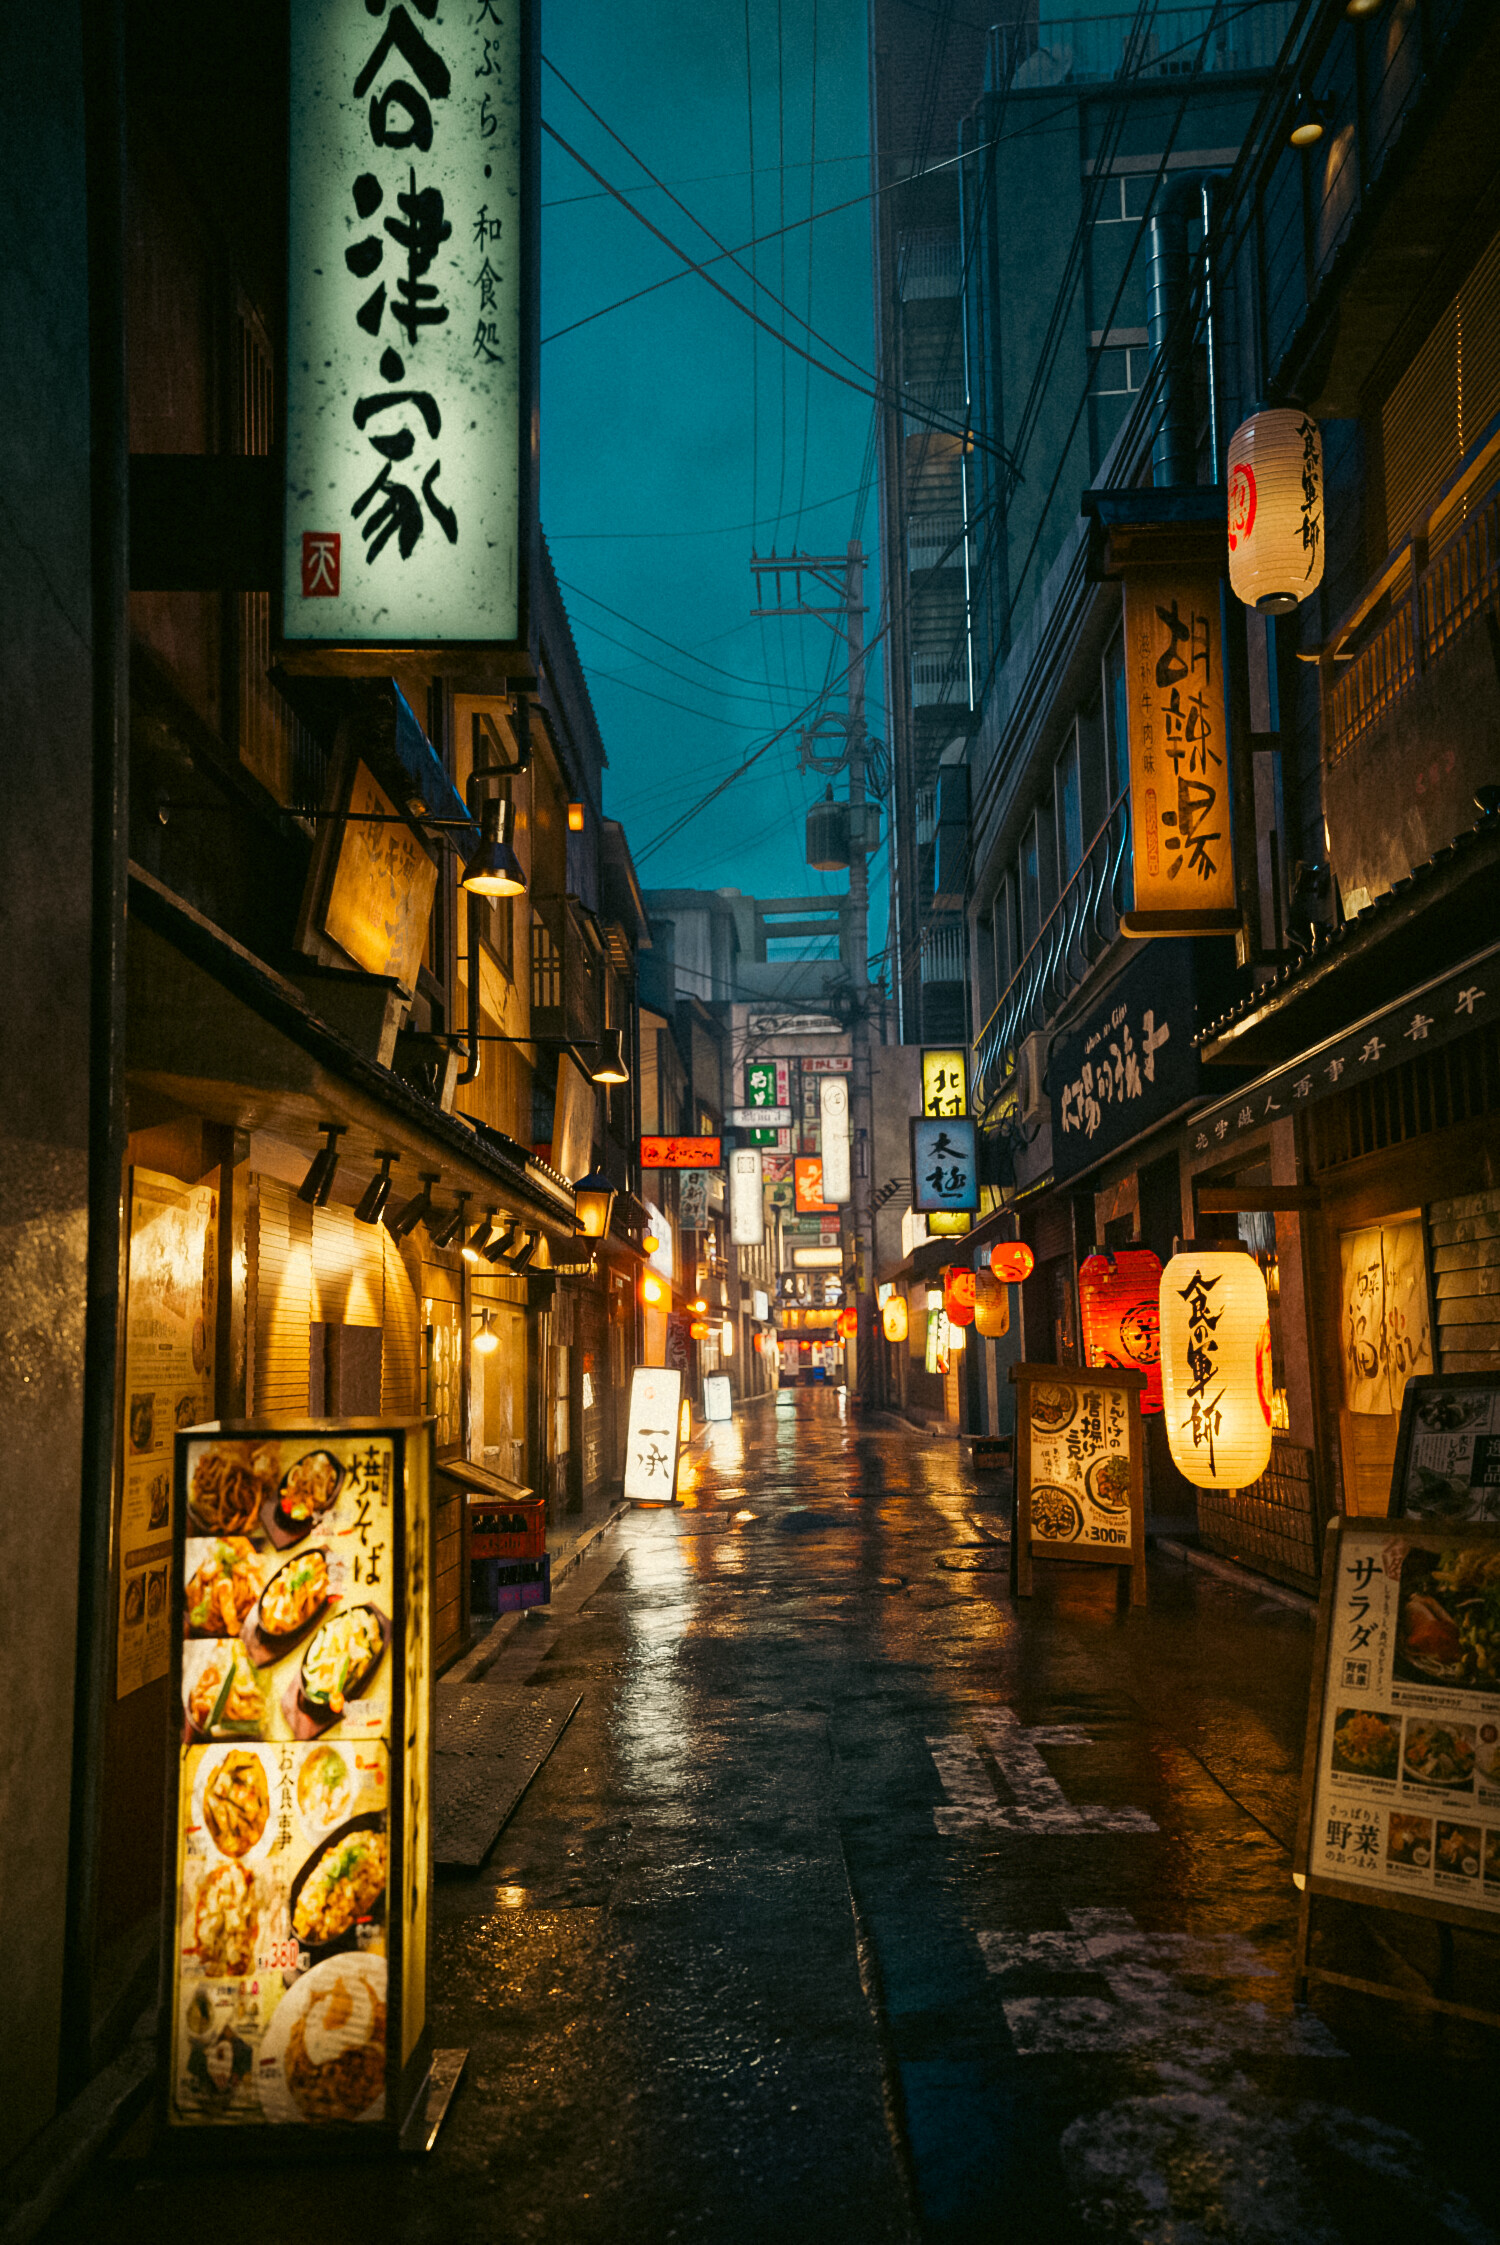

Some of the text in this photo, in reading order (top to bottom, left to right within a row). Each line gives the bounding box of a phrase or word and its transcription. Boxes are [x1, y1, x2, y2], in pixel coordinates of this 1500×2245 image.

[1177, 1269, 1227, 1478] 食の軍師
[1346, 1556, 1383, 1653] サラダ
[1326, 1819, 1380, 1856] 野菜
[1330, 1804, 1380, 1824] さっぱりと
